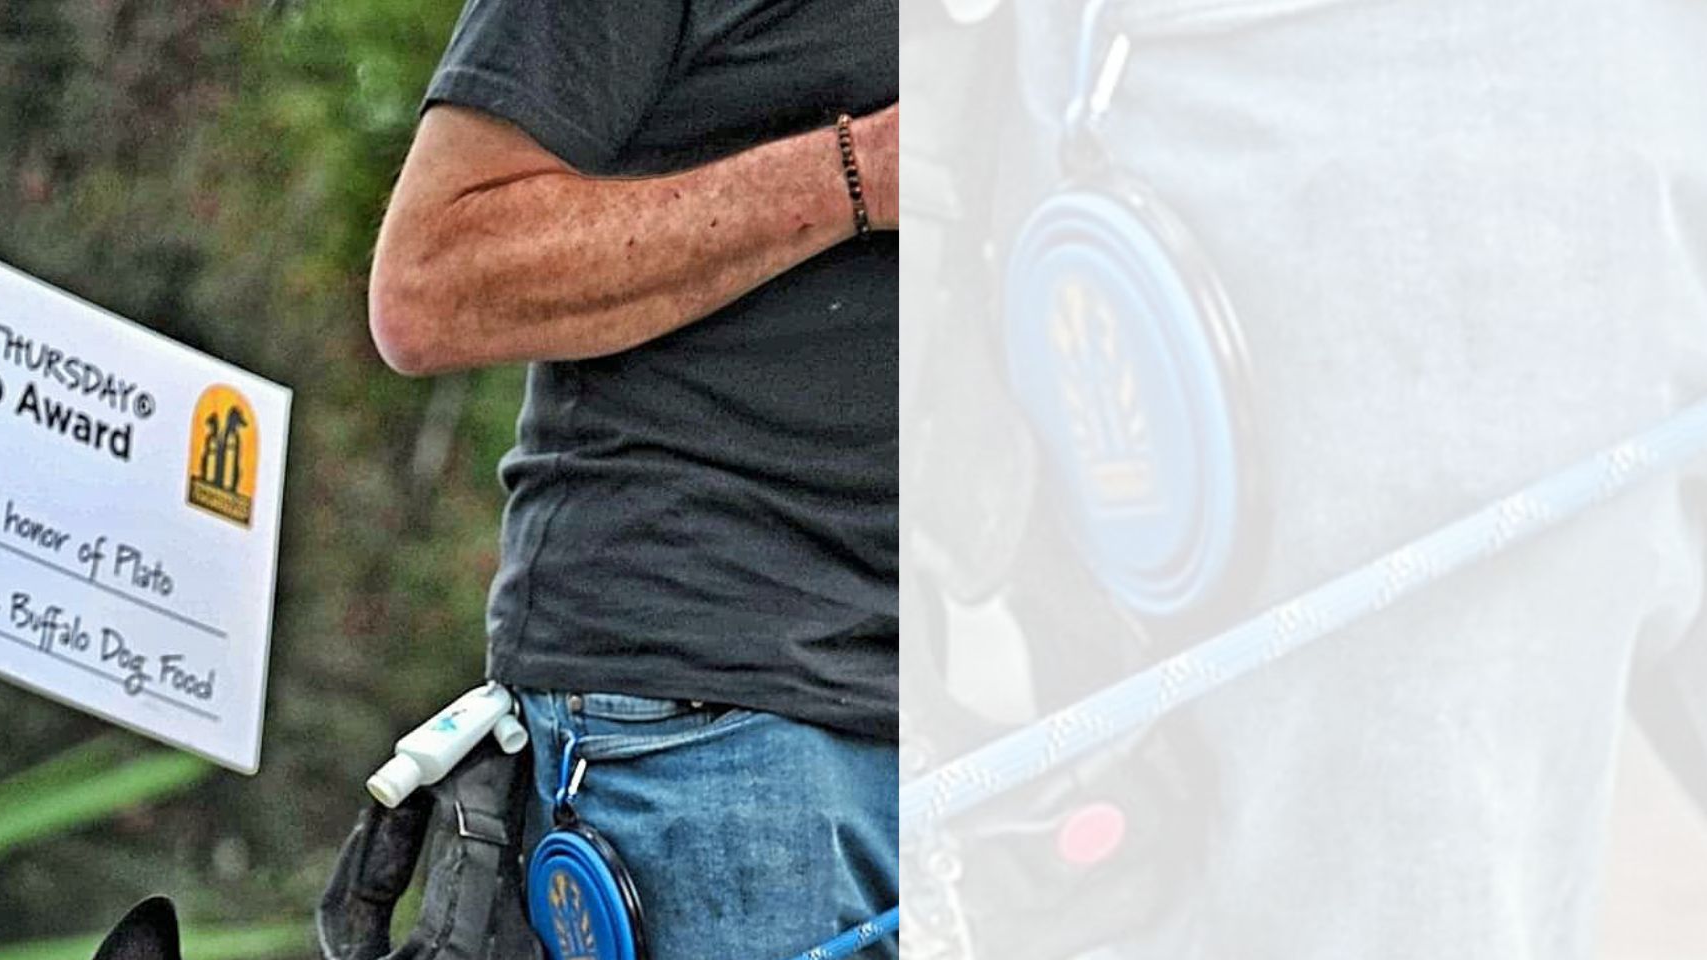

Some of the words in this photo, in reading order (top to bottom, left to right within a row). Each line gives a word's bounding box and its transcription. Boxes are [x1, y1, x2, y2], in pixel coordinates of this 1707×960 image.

[15, 381, 135, 463] Award
[3, 499, 71, 552] honor
[77, 536, 108, 582] of
[113, 543, 175, 597] Plato
[9, 592, 91, 653] Buffalo
[100, 626, 153, 697] Dog
[158, 653, 216, 701] Food
